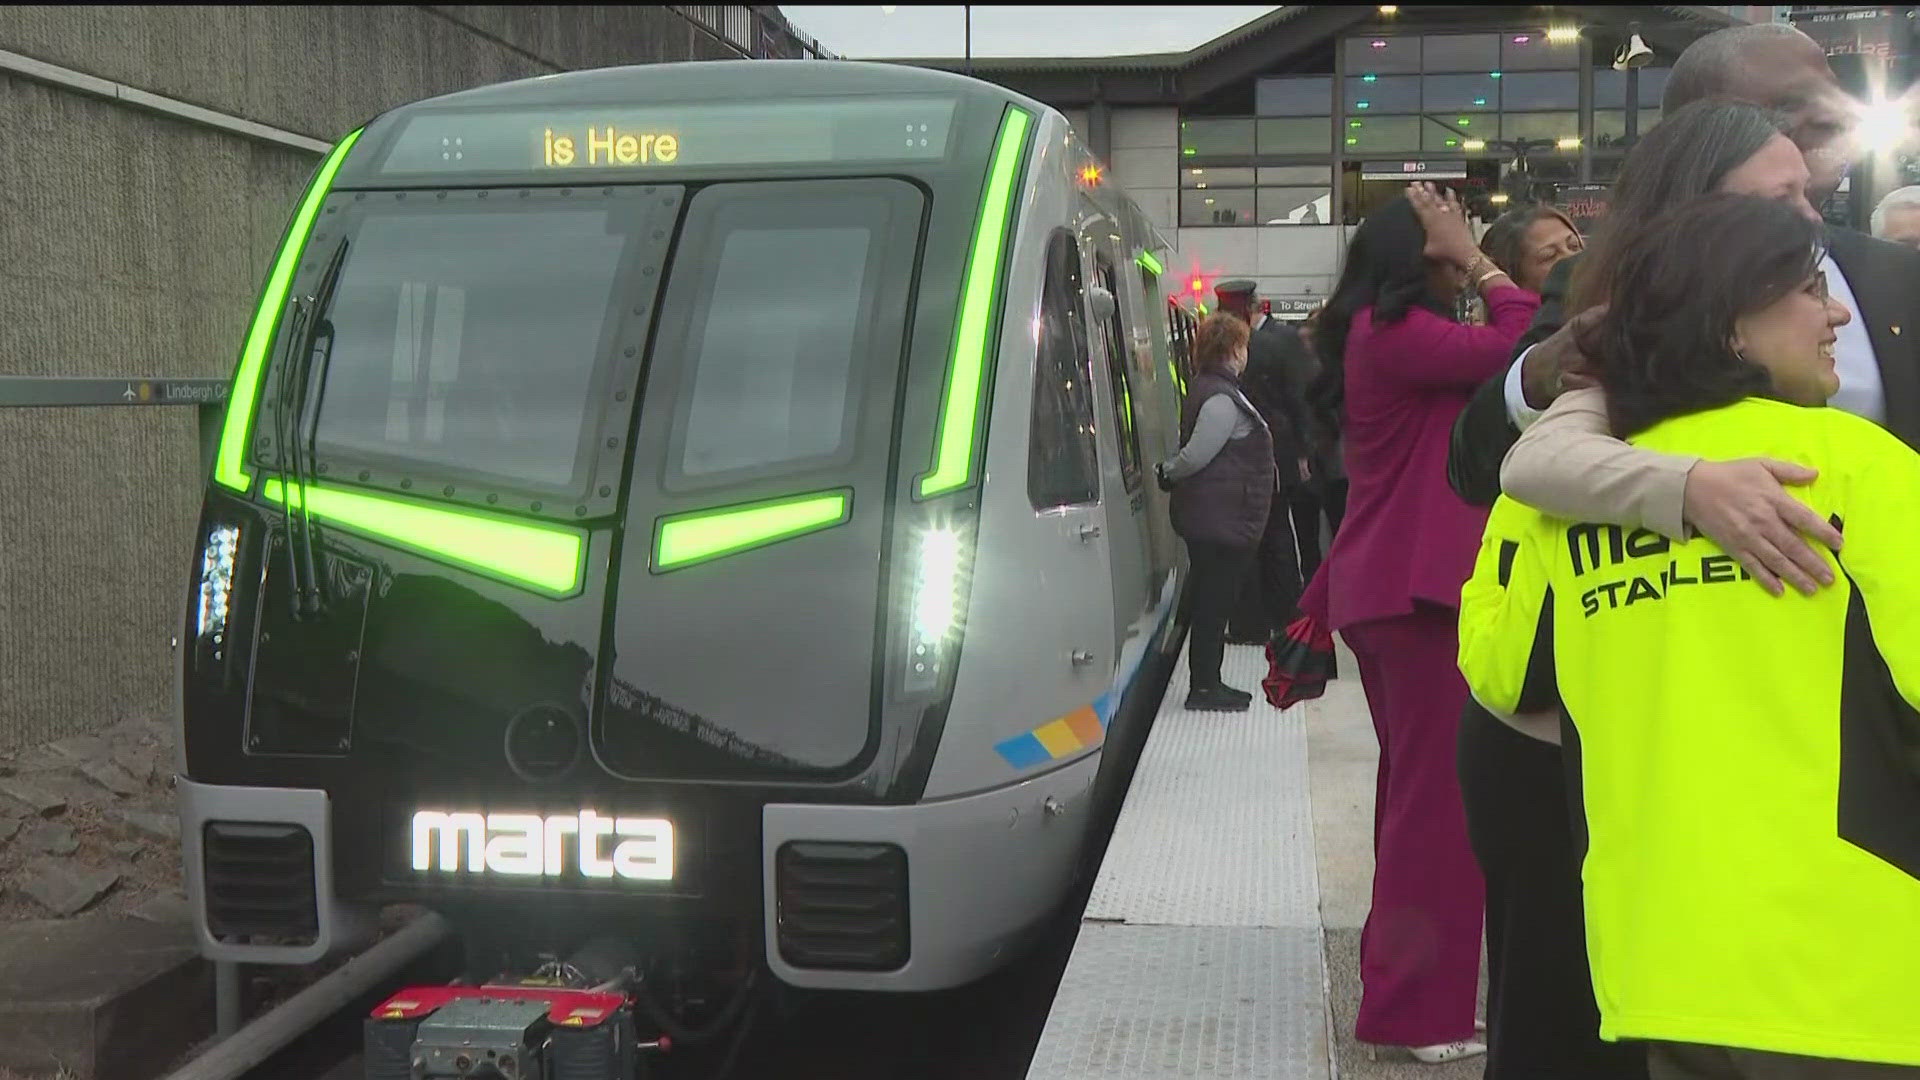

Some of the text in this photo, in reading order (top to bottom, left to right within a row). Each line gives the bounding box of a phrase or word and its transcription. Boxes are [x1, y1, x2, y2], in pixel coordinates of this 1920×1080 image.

[544, 126, 678, 166] is Here
[1281, 301, 1291, 310] To
[166, 383, 213, 400] Lindbergh
[412, 809, 674, 880] marta
